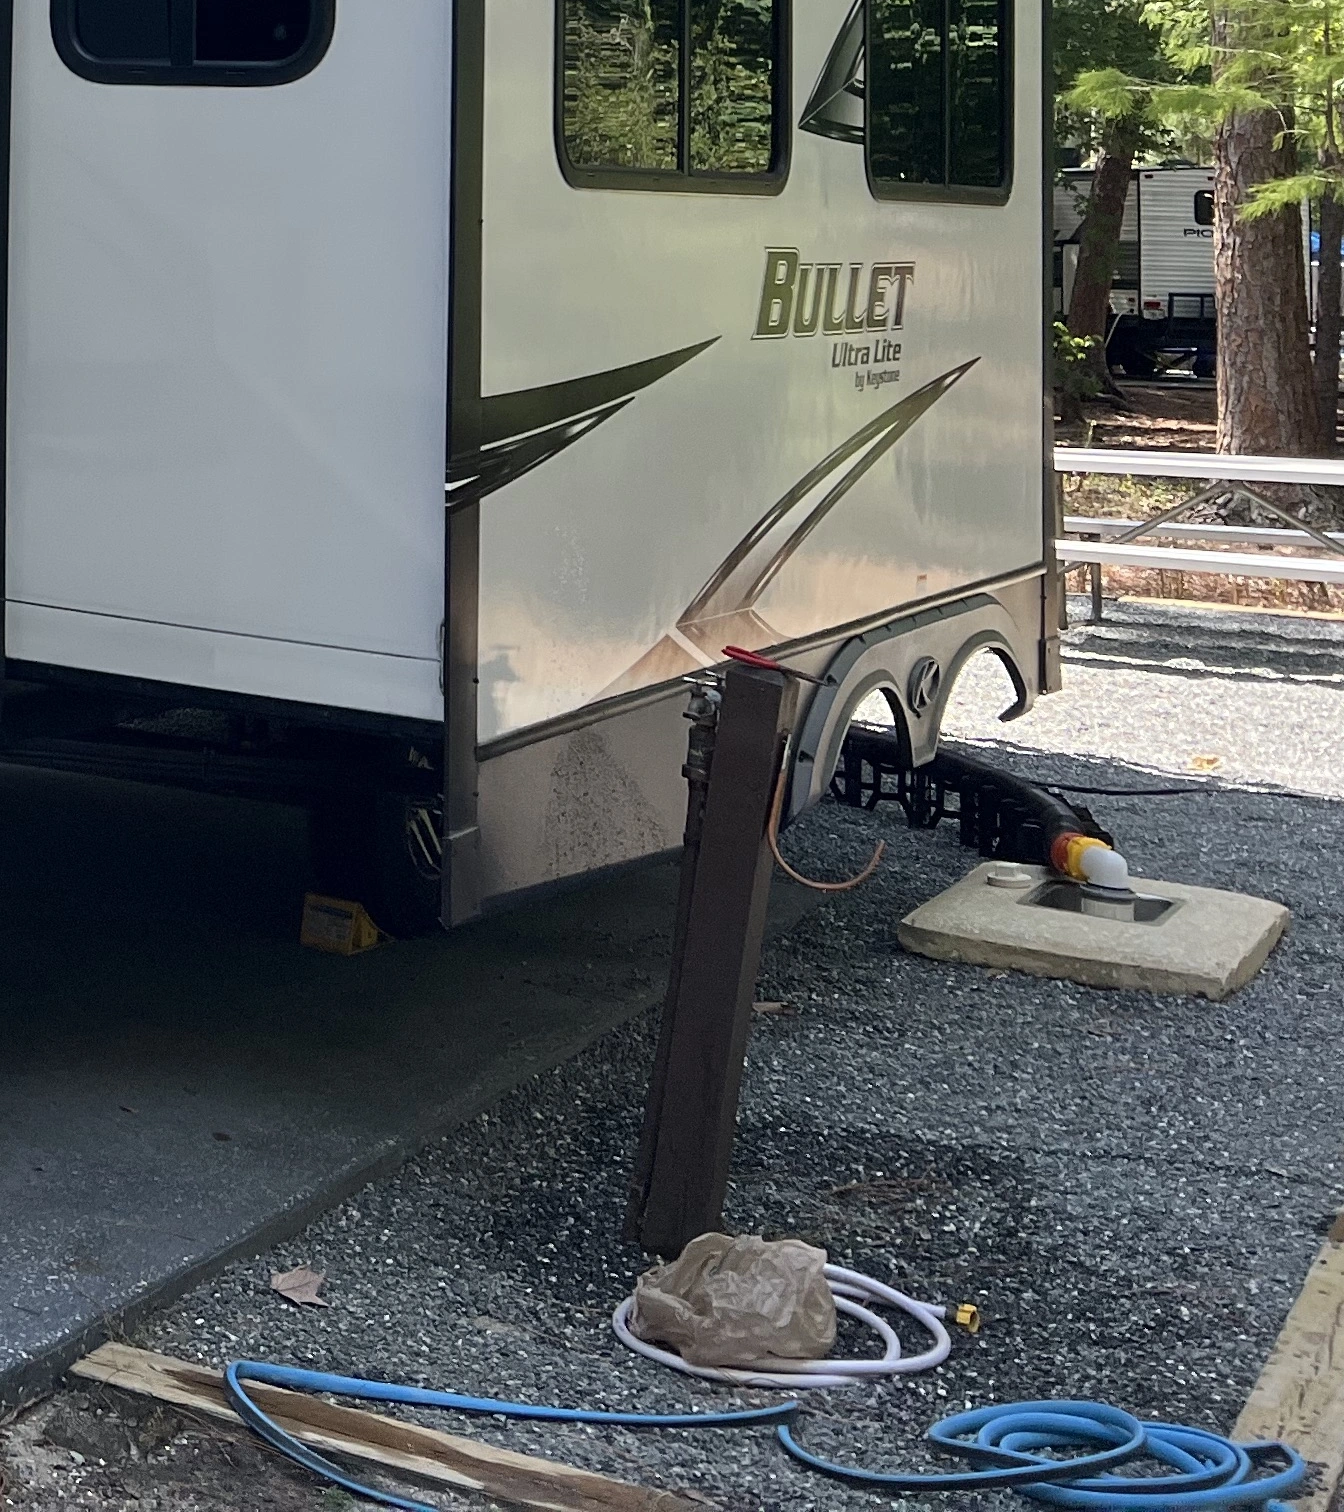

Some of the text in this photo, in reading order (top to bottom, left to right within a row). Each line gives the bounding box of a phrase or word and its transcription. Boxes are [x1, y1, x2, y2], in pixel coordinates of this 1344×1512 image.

[750, 246, 916, 340] BULLET
[831, 338, 902, 368] Ultra Lite
[854, 369, 900, 392] by Keystone
